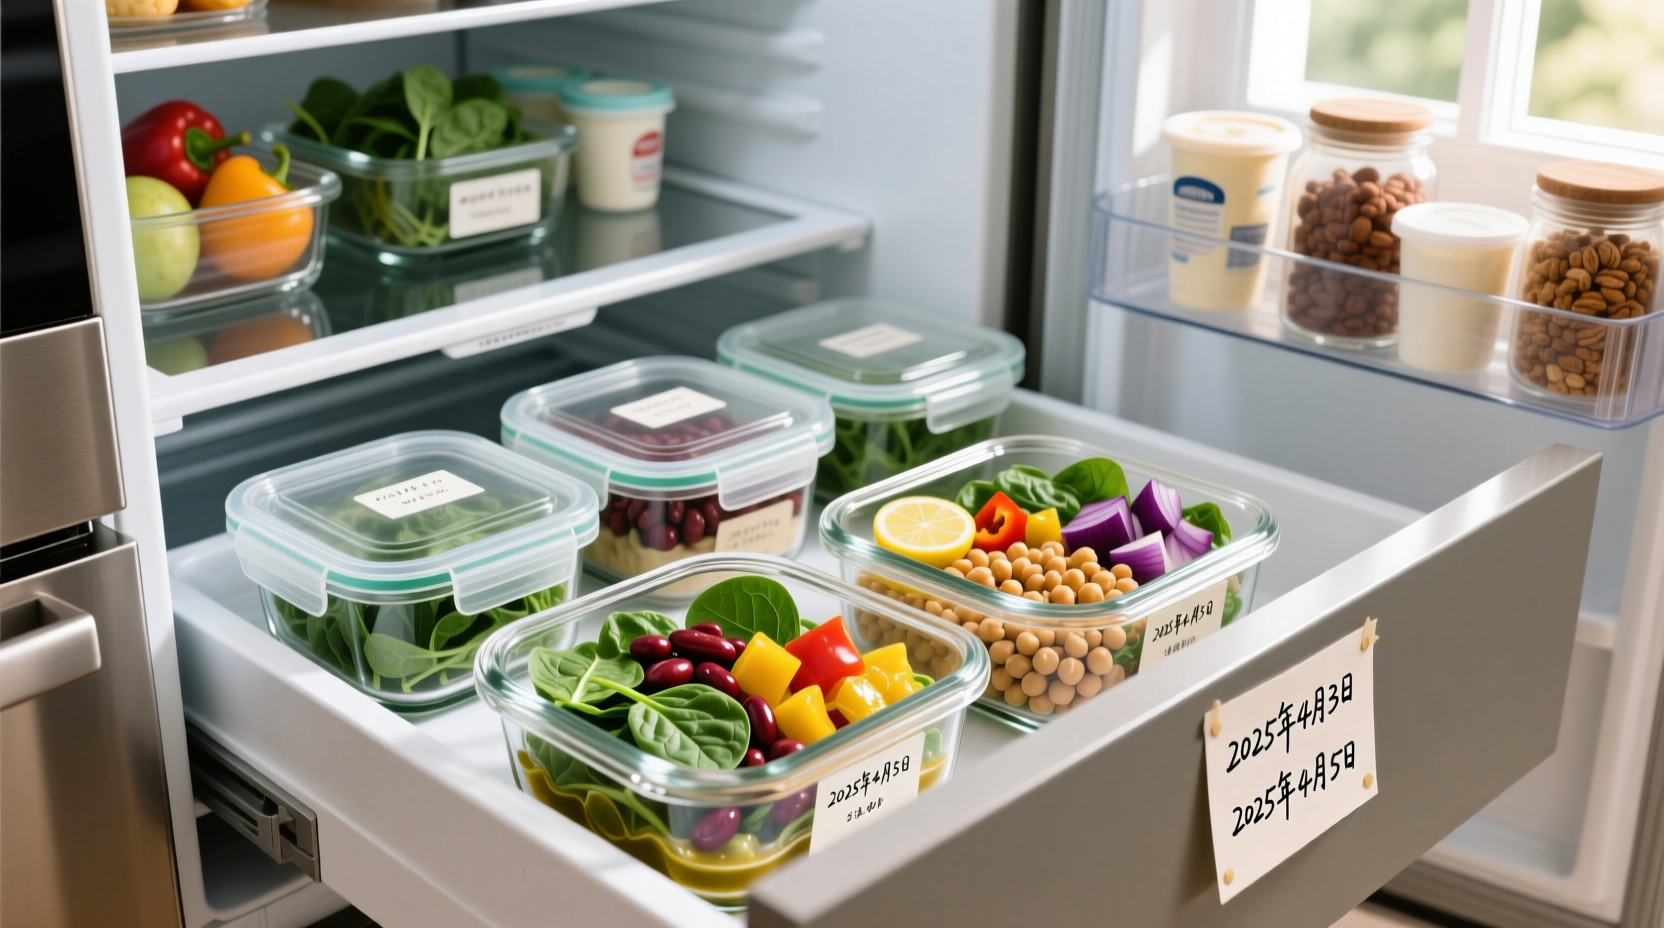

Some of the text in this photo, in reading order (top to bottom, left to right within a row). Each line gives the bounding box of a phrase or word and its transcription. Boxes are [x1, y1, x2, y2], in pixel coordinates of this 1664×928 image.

[1226, 672, 1353, 773] 2025年4月3日
[827, 755, 910, 808] 2025年4月5日
[1232, 740, 1355, 837] 2025年4月5日
